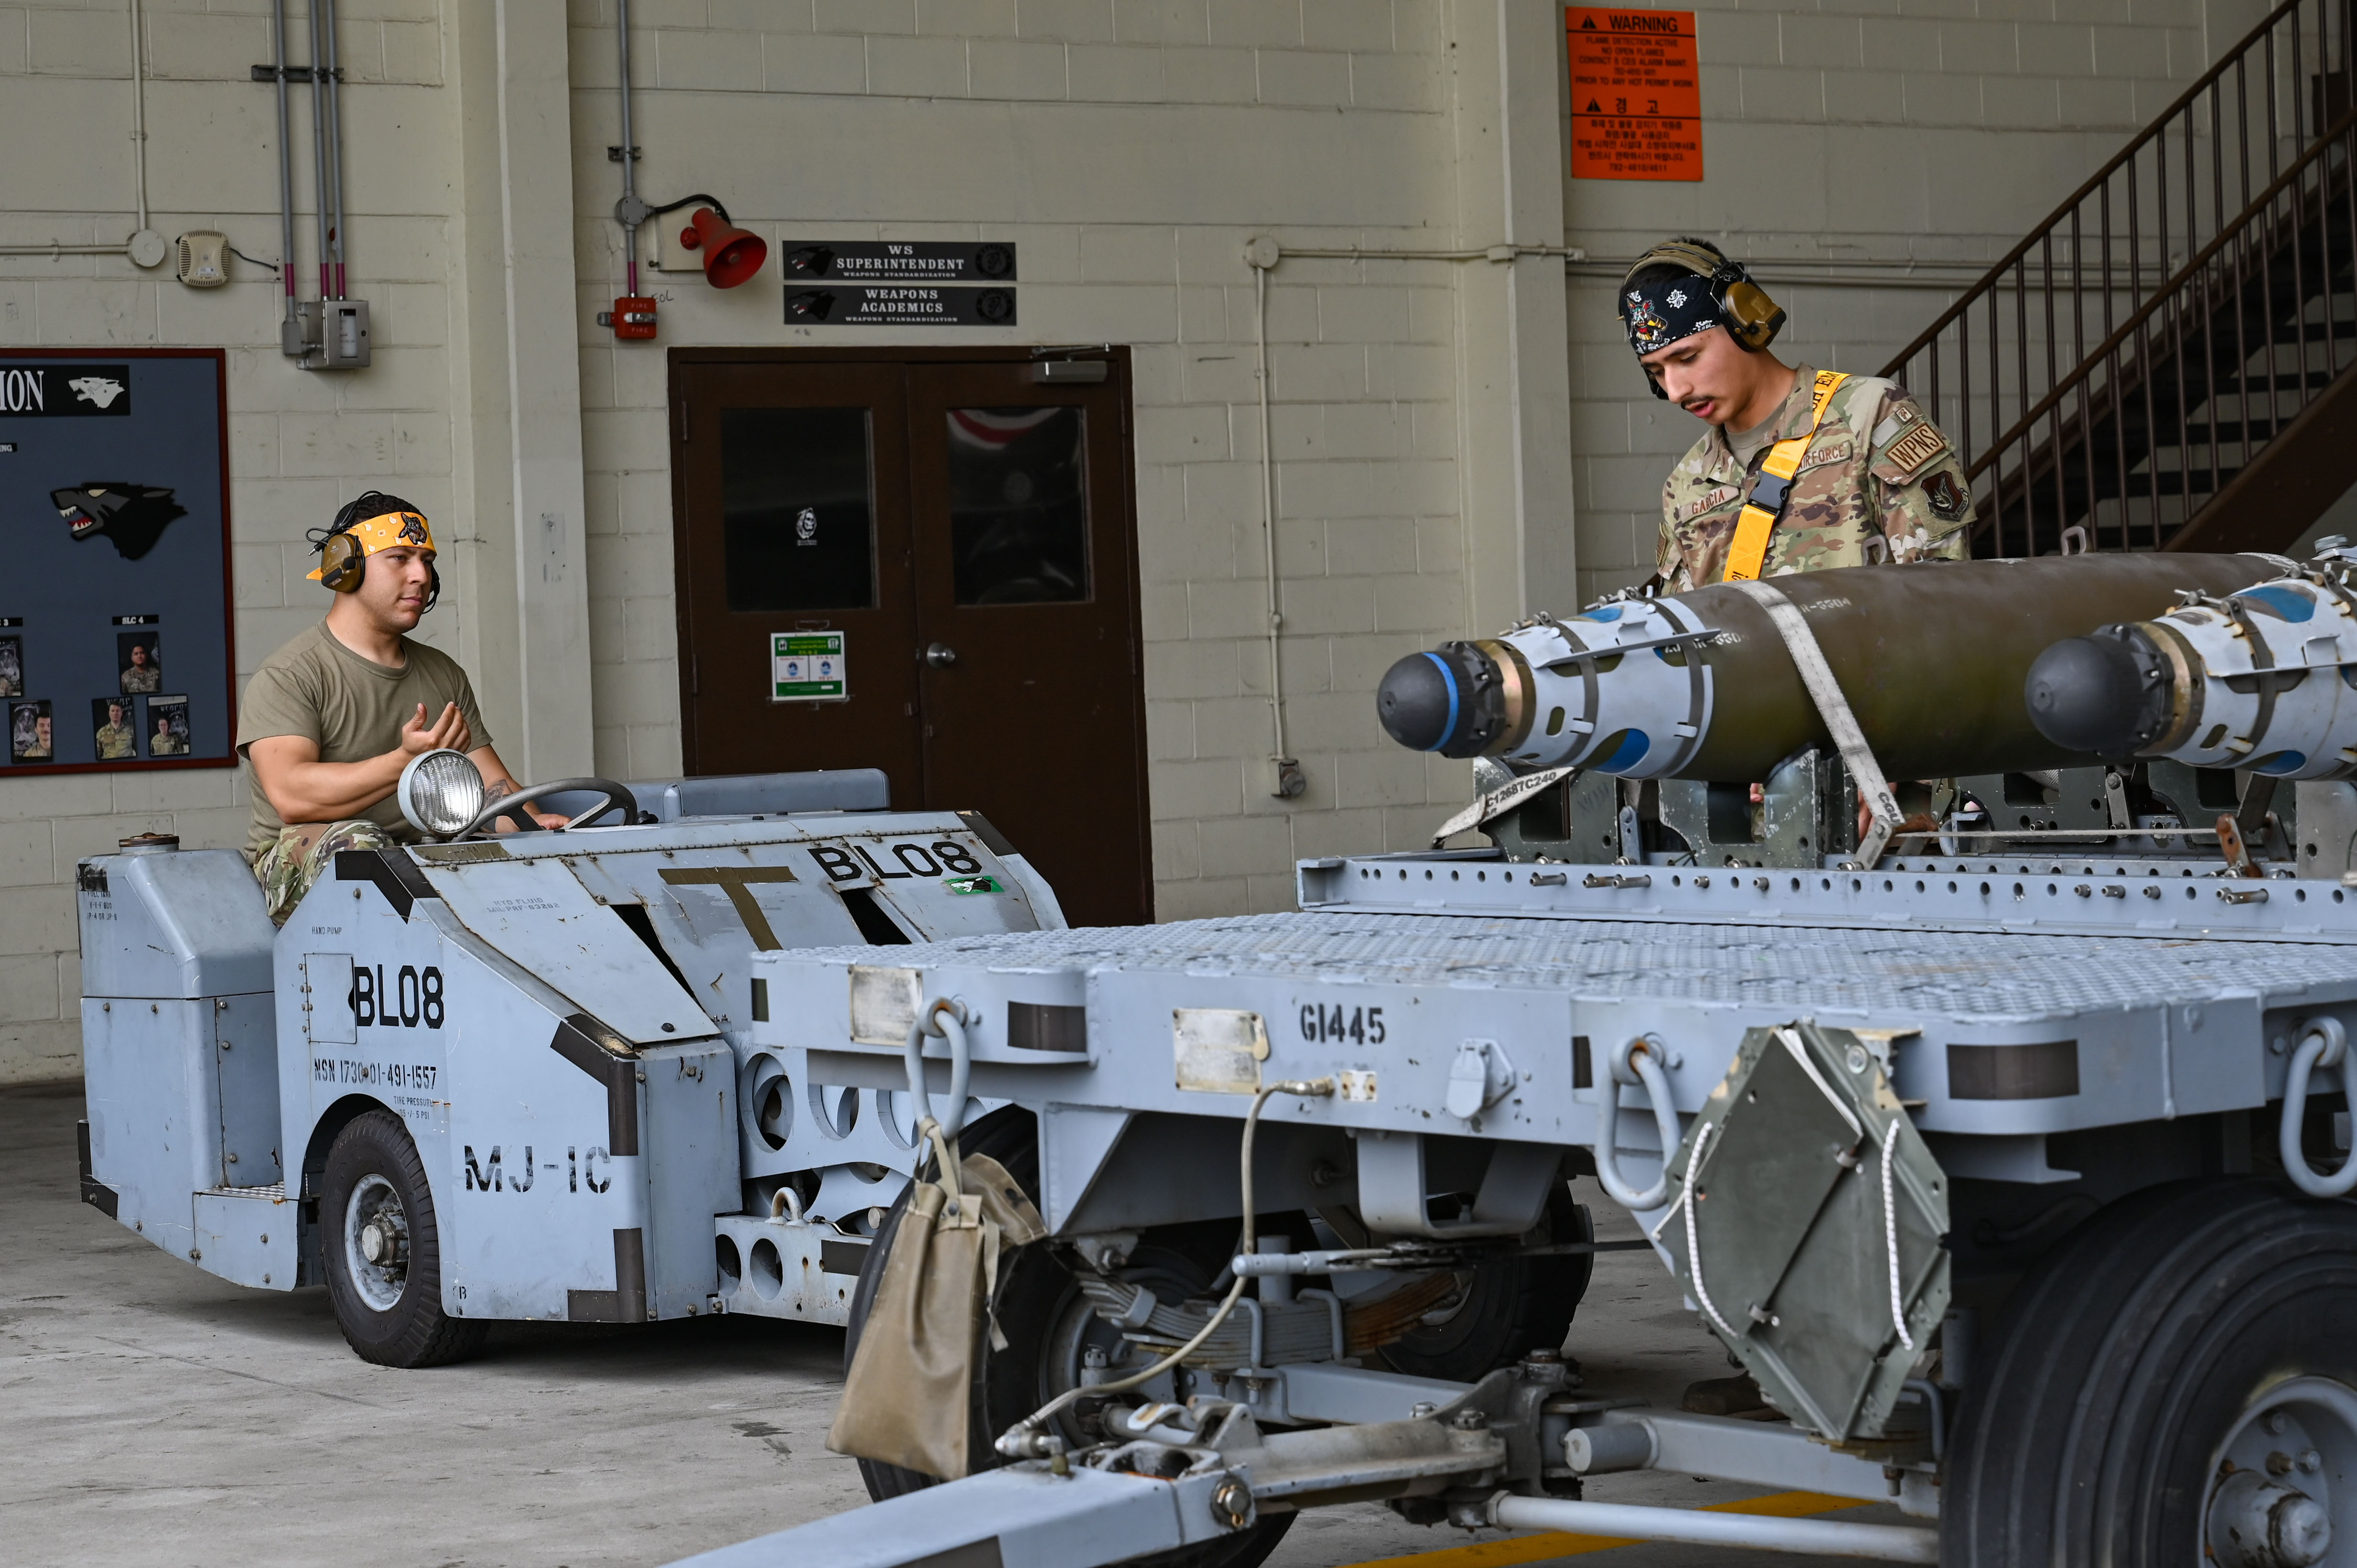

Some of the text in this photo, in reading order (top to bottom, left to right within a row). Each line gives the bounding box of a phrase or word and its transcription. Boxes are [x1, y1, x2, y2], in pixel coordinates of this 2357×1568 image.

[1609, 15, 1678, 32] WARNING
[1586, 36, 1678, 47] FLAME DETECTION ACTIVE
[1637, 48, 1664, 56] FLAMES
[1579, 56, 1611, 65] CONTACT
[1639, 58, 1663, 66] ALARM
[1575, 76, 1597, 84] PRIOR
[1600, 77, 1609, 85] TO
[1645, 79, 1670, 87] PERMIT
[1616, 97, 1659, 114] 경 고
[888, 245, 913, 255] WS
[837, 258, 964, 270] SUPERINTENDENT
[865, 289, 938, 300] WEAPONS
[861, 302, 944, 313] ACADEMICS
[1891, 429, 1942, 468] WPNS
[1811, 444, 1845, 465] FORCE
[1691, 489, 1726, 515] GARCIA
[122, 616, 144, 625] SLC 4
[807, 841, 983, 882] BL08
[487, 902, 561, 913] MIL-PRF-83282
[87, 912, 97, 920] JP-4
[312, 926, 342, 935] HAND PUMP
[354, 964, 445, 1029] BL08
[1300, 1003, 1386, 1045] G1445
[314, 1058, 436, 1090] NSN 173001-491-1557
[393, 1095, 434, 1108] TIRE PRESSURE
[416, 1110, 420, 1119] 5
[421, 1111, 430, 1120] PSI
[464, 1145, 612, 1194] MJ-1C
